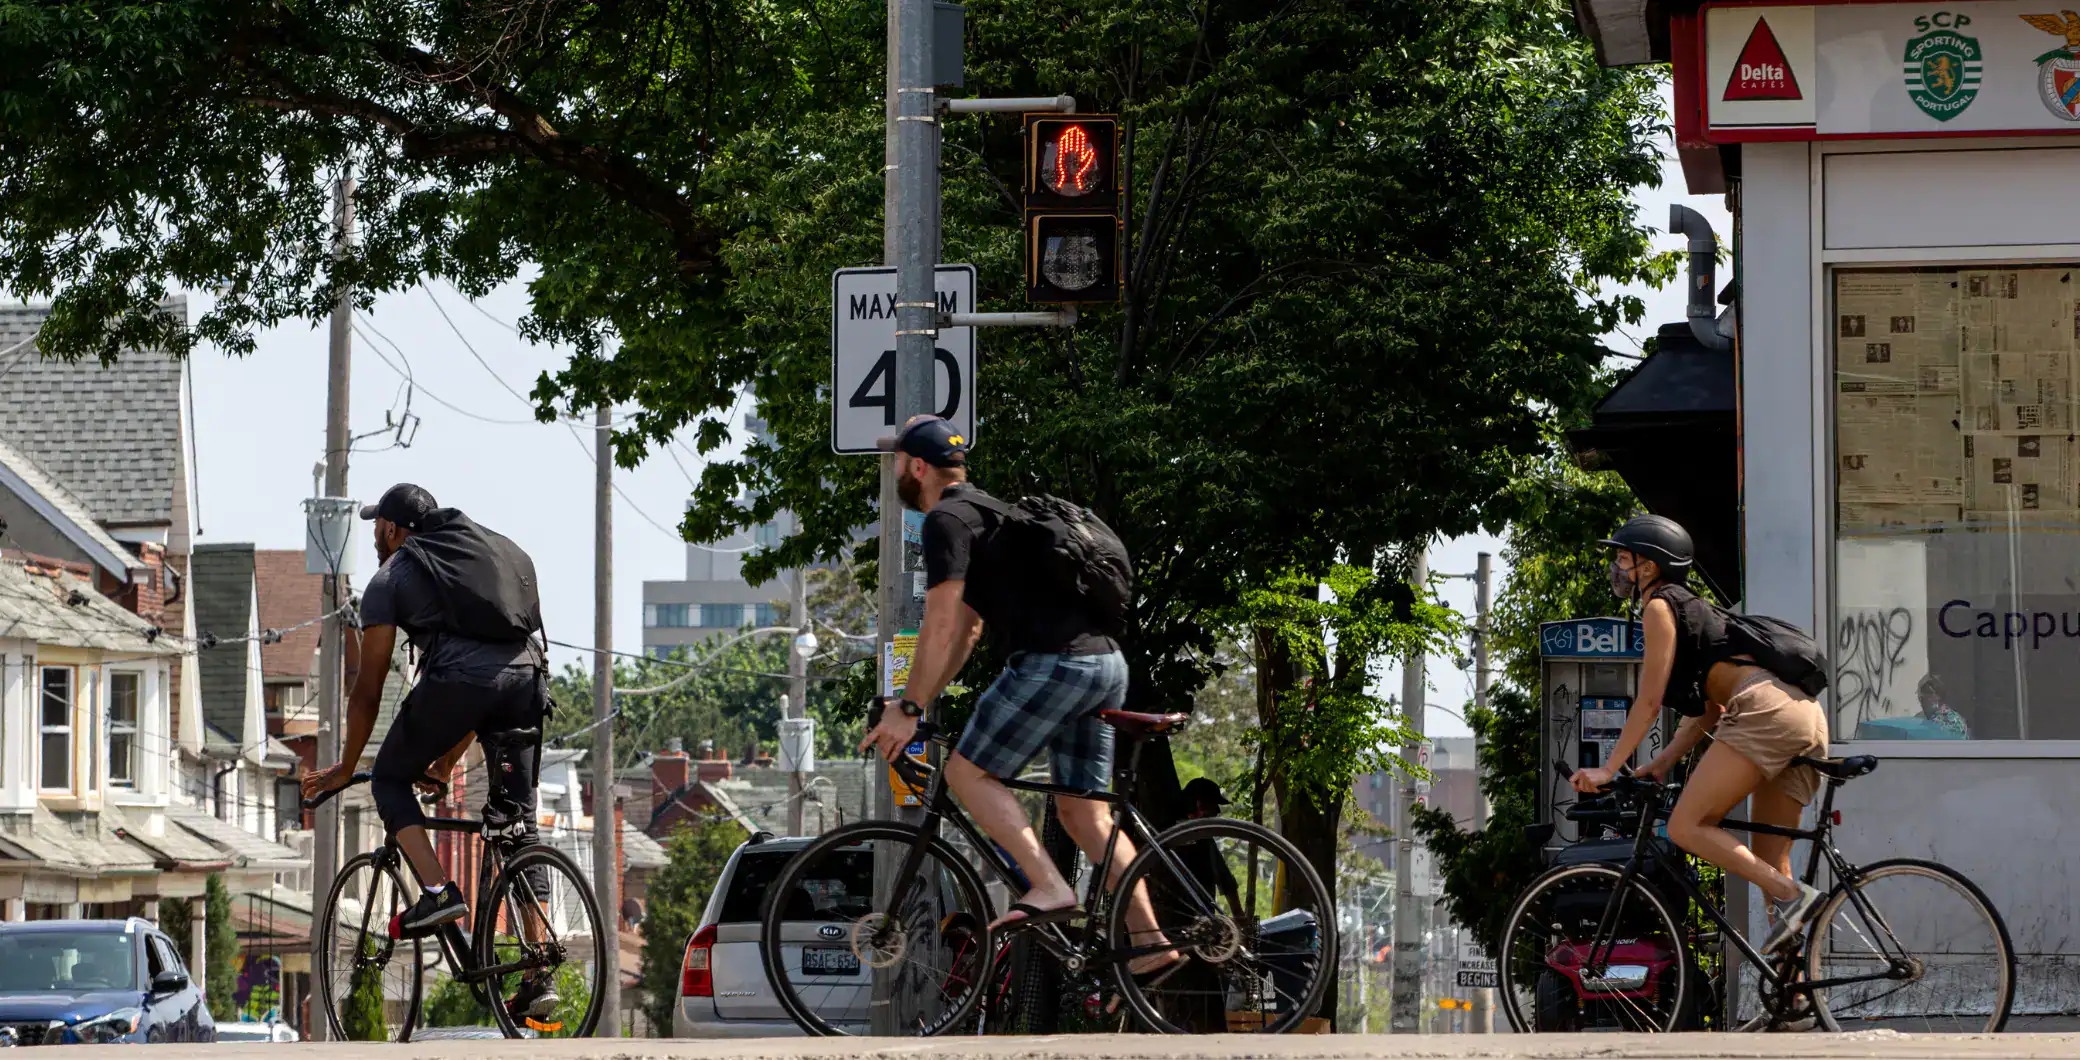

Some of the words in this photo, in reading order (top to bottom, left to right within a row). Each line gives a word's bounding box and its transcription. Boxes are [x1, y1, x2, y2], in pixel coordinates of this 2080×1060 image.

[1913, 11, 1972, 32] SCP
[1910, 36, 1974, 59] SPORTING
[1741, 63, 1784, 81] Delta
[1915, 95, 1973, 111] PORTUGAL
[850, 290, 957, 320] MAXM
[1577, 624, 1626, 653] Bell
[1459, 960, 1498, 970] INCREASE
[1460, 973, 1498, 986] BEGINS
